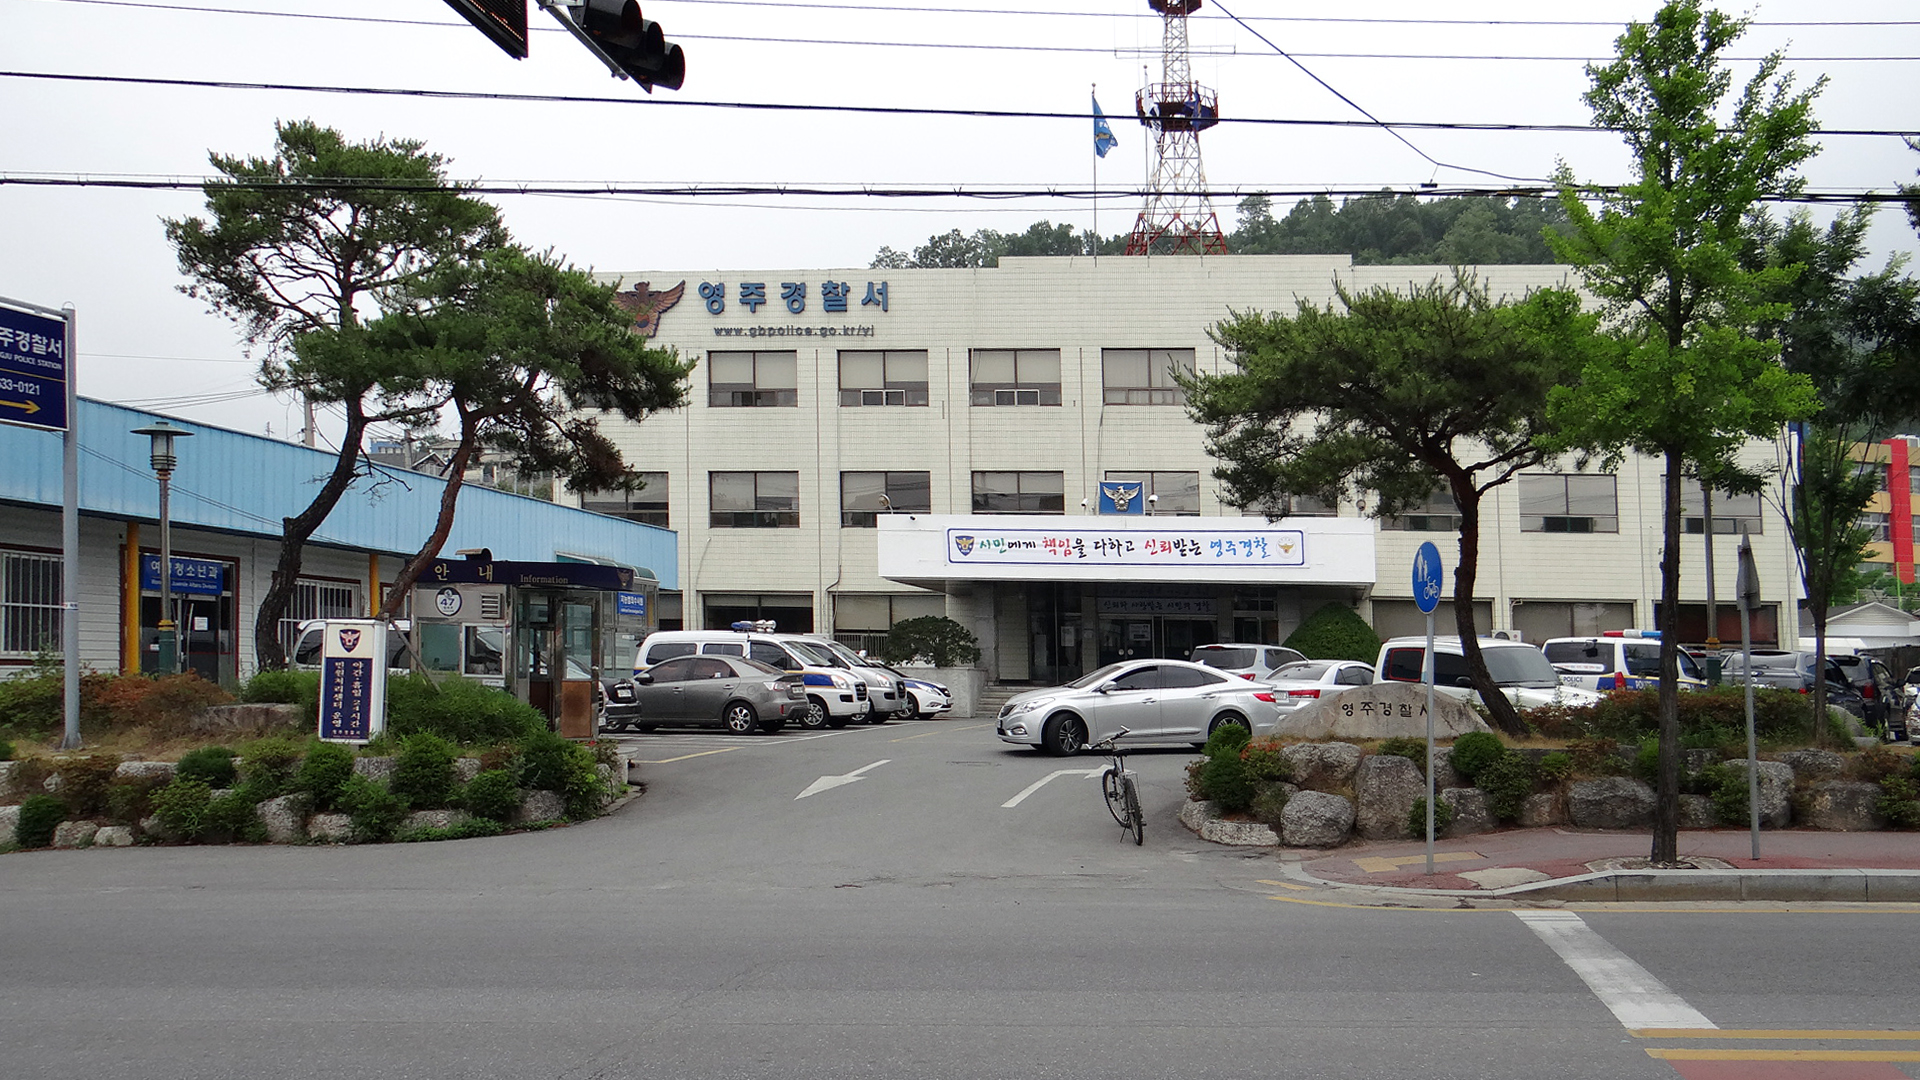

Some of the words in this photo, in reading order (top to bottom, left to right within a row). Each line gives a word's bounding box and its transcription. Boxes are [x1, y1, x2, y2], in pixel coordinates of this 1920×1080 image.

[698, 280, 889, 314] 영주경찰서
[0, 351, 12, 360] GJU
[14, 354, 36, 366] POLICE
[37, 359, 62, 370] STATION
[0, 377, 40, 395] 33-0121
[980, 537, 1036, 554] 시민에게
[1042, 536, 1087, 559] 책임을
[1093, 537, 1135, 557] 다하고
[1144, 538, 1202, 557] 신뢰받는
[1210, 536, 1271, 559] 영주경찰
[151, 560, 218, 579] 여청소년과
[520, 574, 569, 584] Information
[440, 597, 455, 606] 47
[332, 711, 343, 728] 운영
